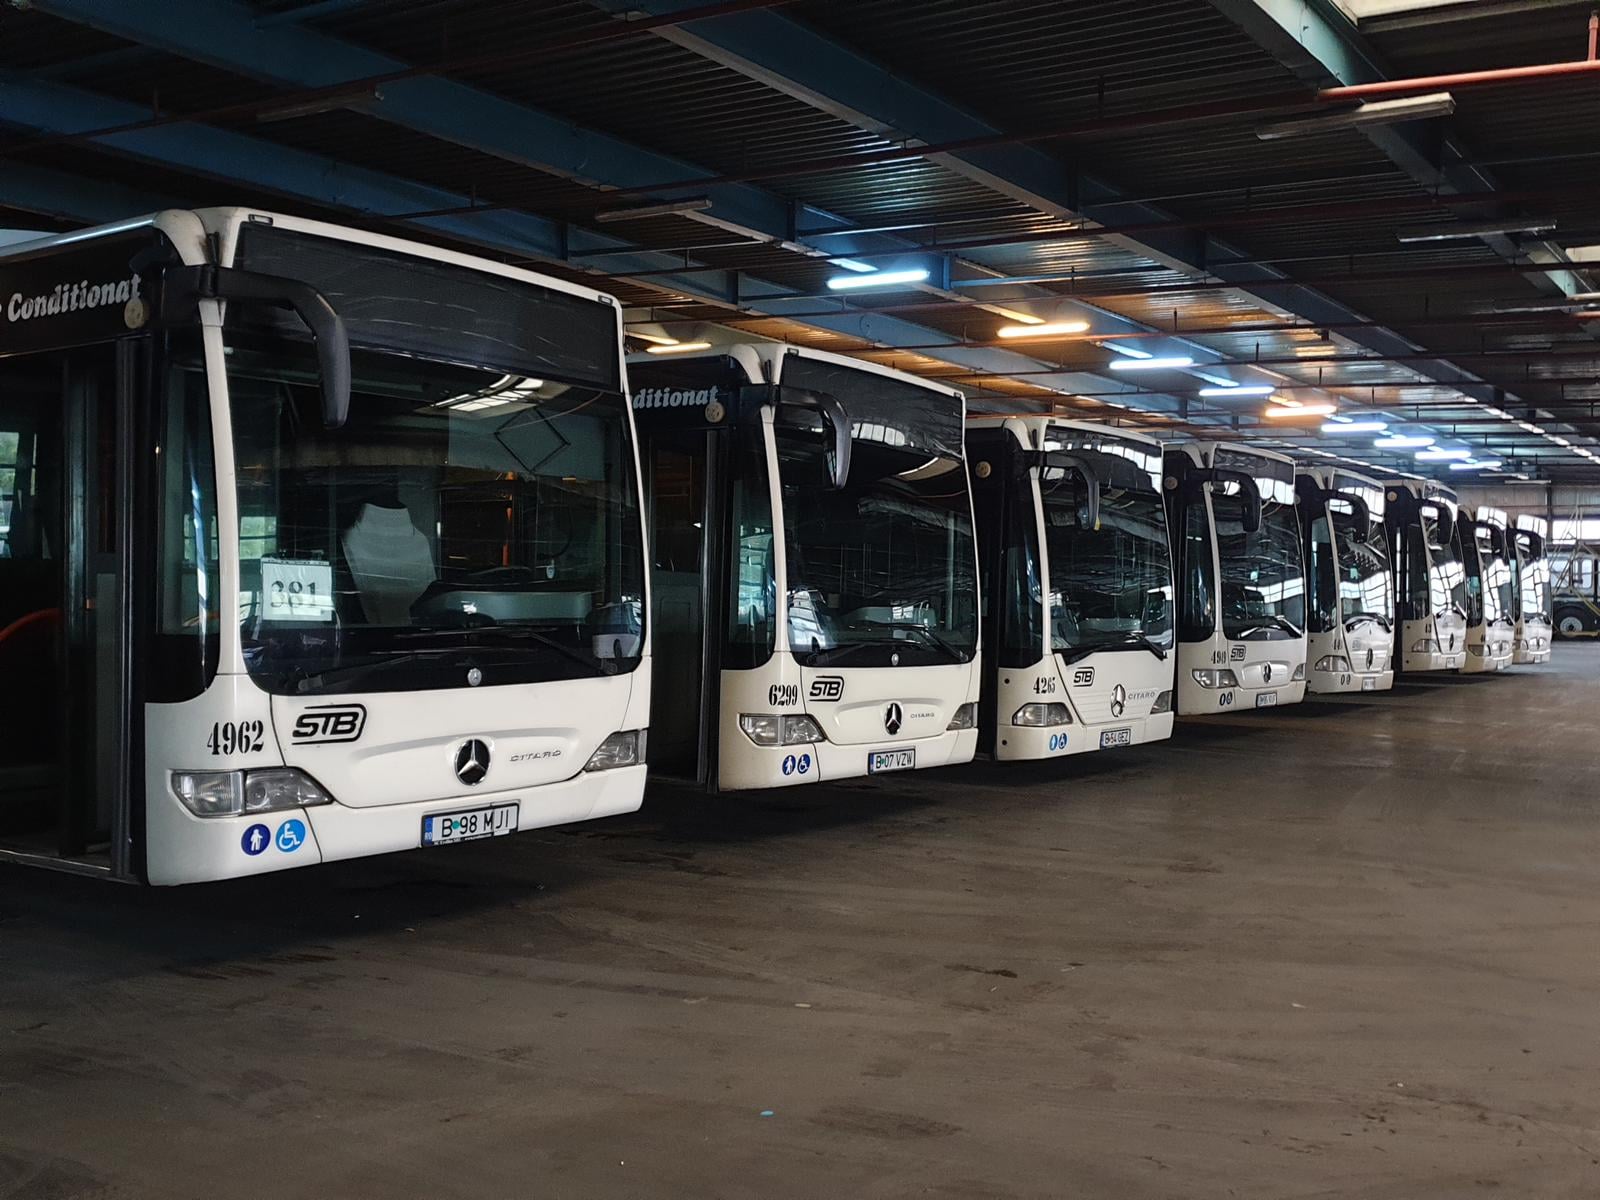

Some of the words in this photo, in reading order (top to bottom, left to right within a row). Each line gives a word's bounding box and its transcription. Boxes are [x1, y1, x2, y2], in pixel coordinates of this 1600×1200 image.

[7, 273, 142, 322] Conditionat
[630, 385, 719, 409] ditionat
[1033, 677, 1056, 694] 4265
[1074, 670, 1093, 683] STB
[768, 684, 798, 707] 6299
[810, 680, 842, 697] STB
[292, 711, 360, 738] STB
[207, 720, 264, 756] 4962
[876, 754, 882, 769] B
[884, 753, 895, 768] 07
[896, 752, 913, 767] VZW
[442, 818, 453, 838] B
[460, 814, 478, 835] 98
[484, 808, 509, 832] MJI
